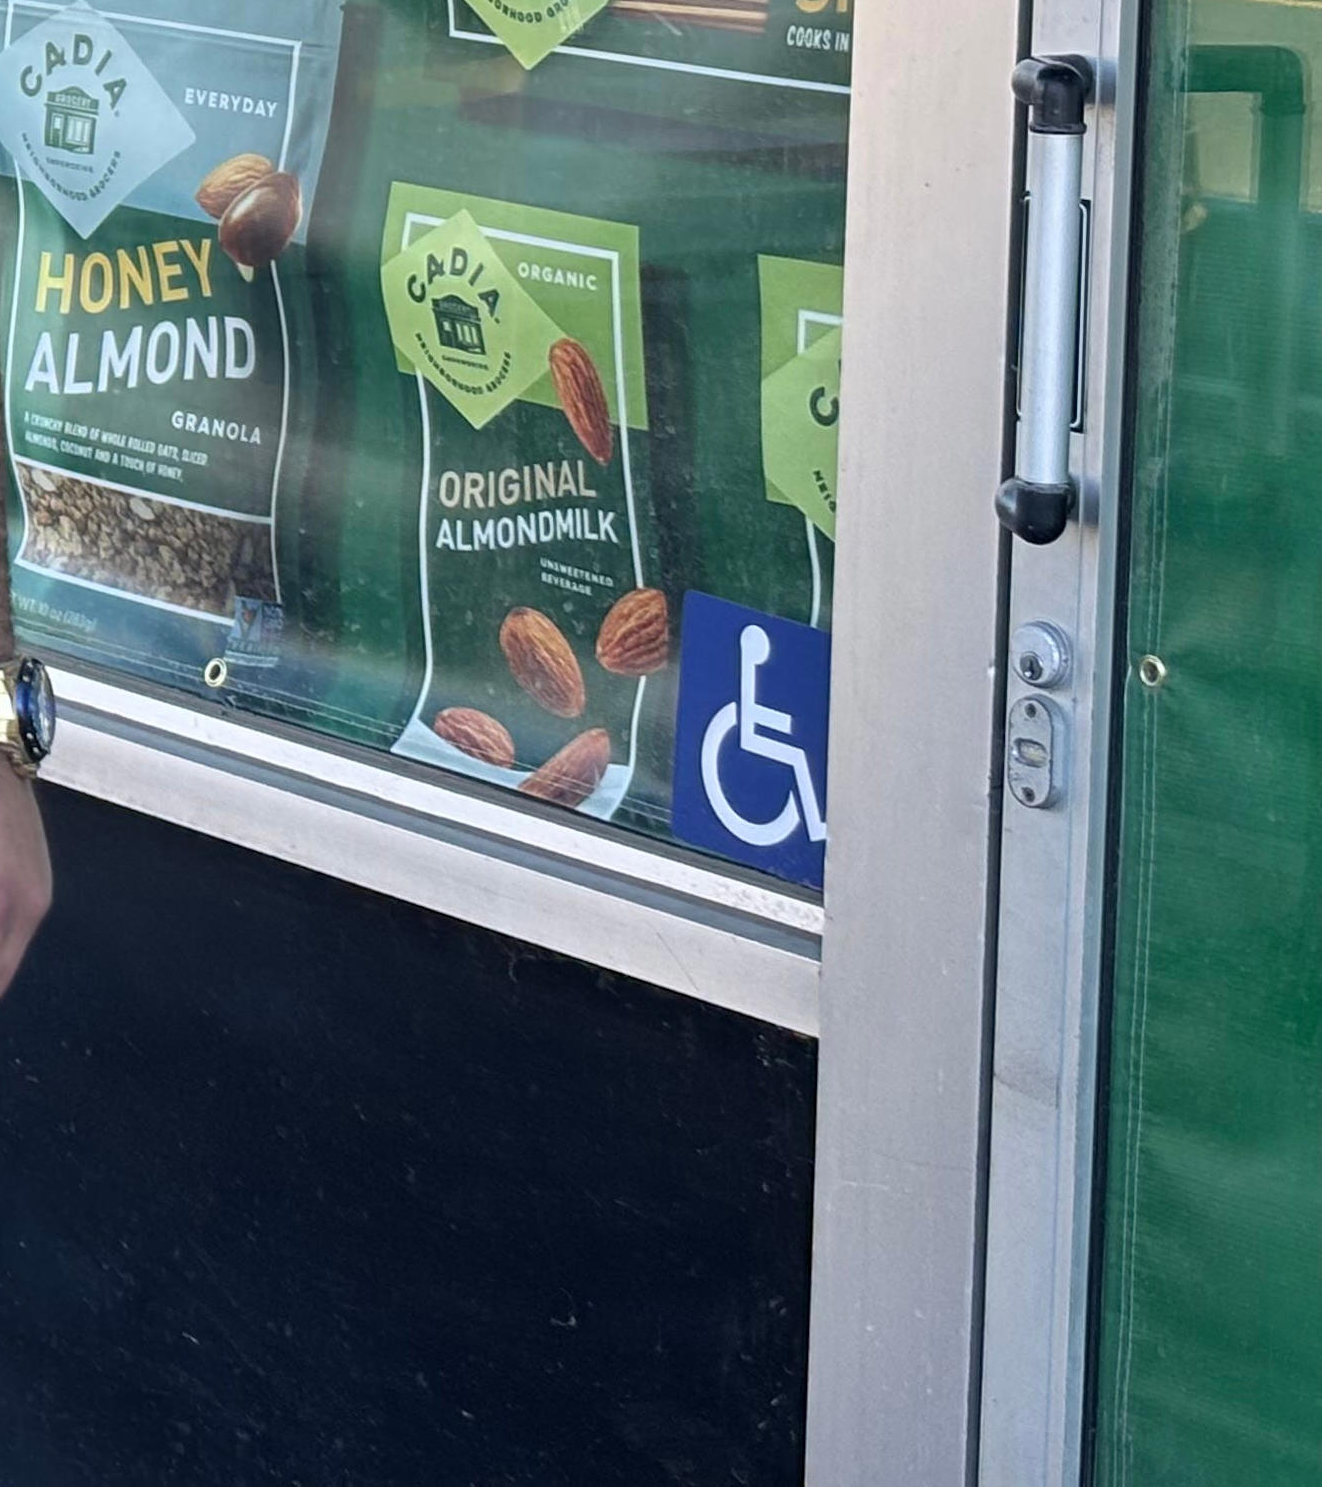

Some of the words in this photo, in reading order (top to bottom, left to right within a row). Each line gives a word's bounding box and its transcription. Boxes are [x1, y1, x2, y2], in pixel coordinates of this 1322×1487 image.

[786, 25, 832, 50] COOKS
[834, 29, 850, 52] IN
[19, 32, 128, 111] CADIA
[184, 87, 278, 120] EVERYDAY
[34, 238, 213, 314] HONEY
[406, 245, 501, 319] CADIA
[517, 260, 598, 292] ORGANIC
[24, 315, 257, 396] ALMOND
[171, 410, 262, 445] GRANOLA
[438, 459, 598, 511] ORIGINAL
[434, 509, 619, 552] ALMONDMILK
[539, 556, 614, 587] UNSWEETENED
[540, 571, 593, 596] BEVERAGE
